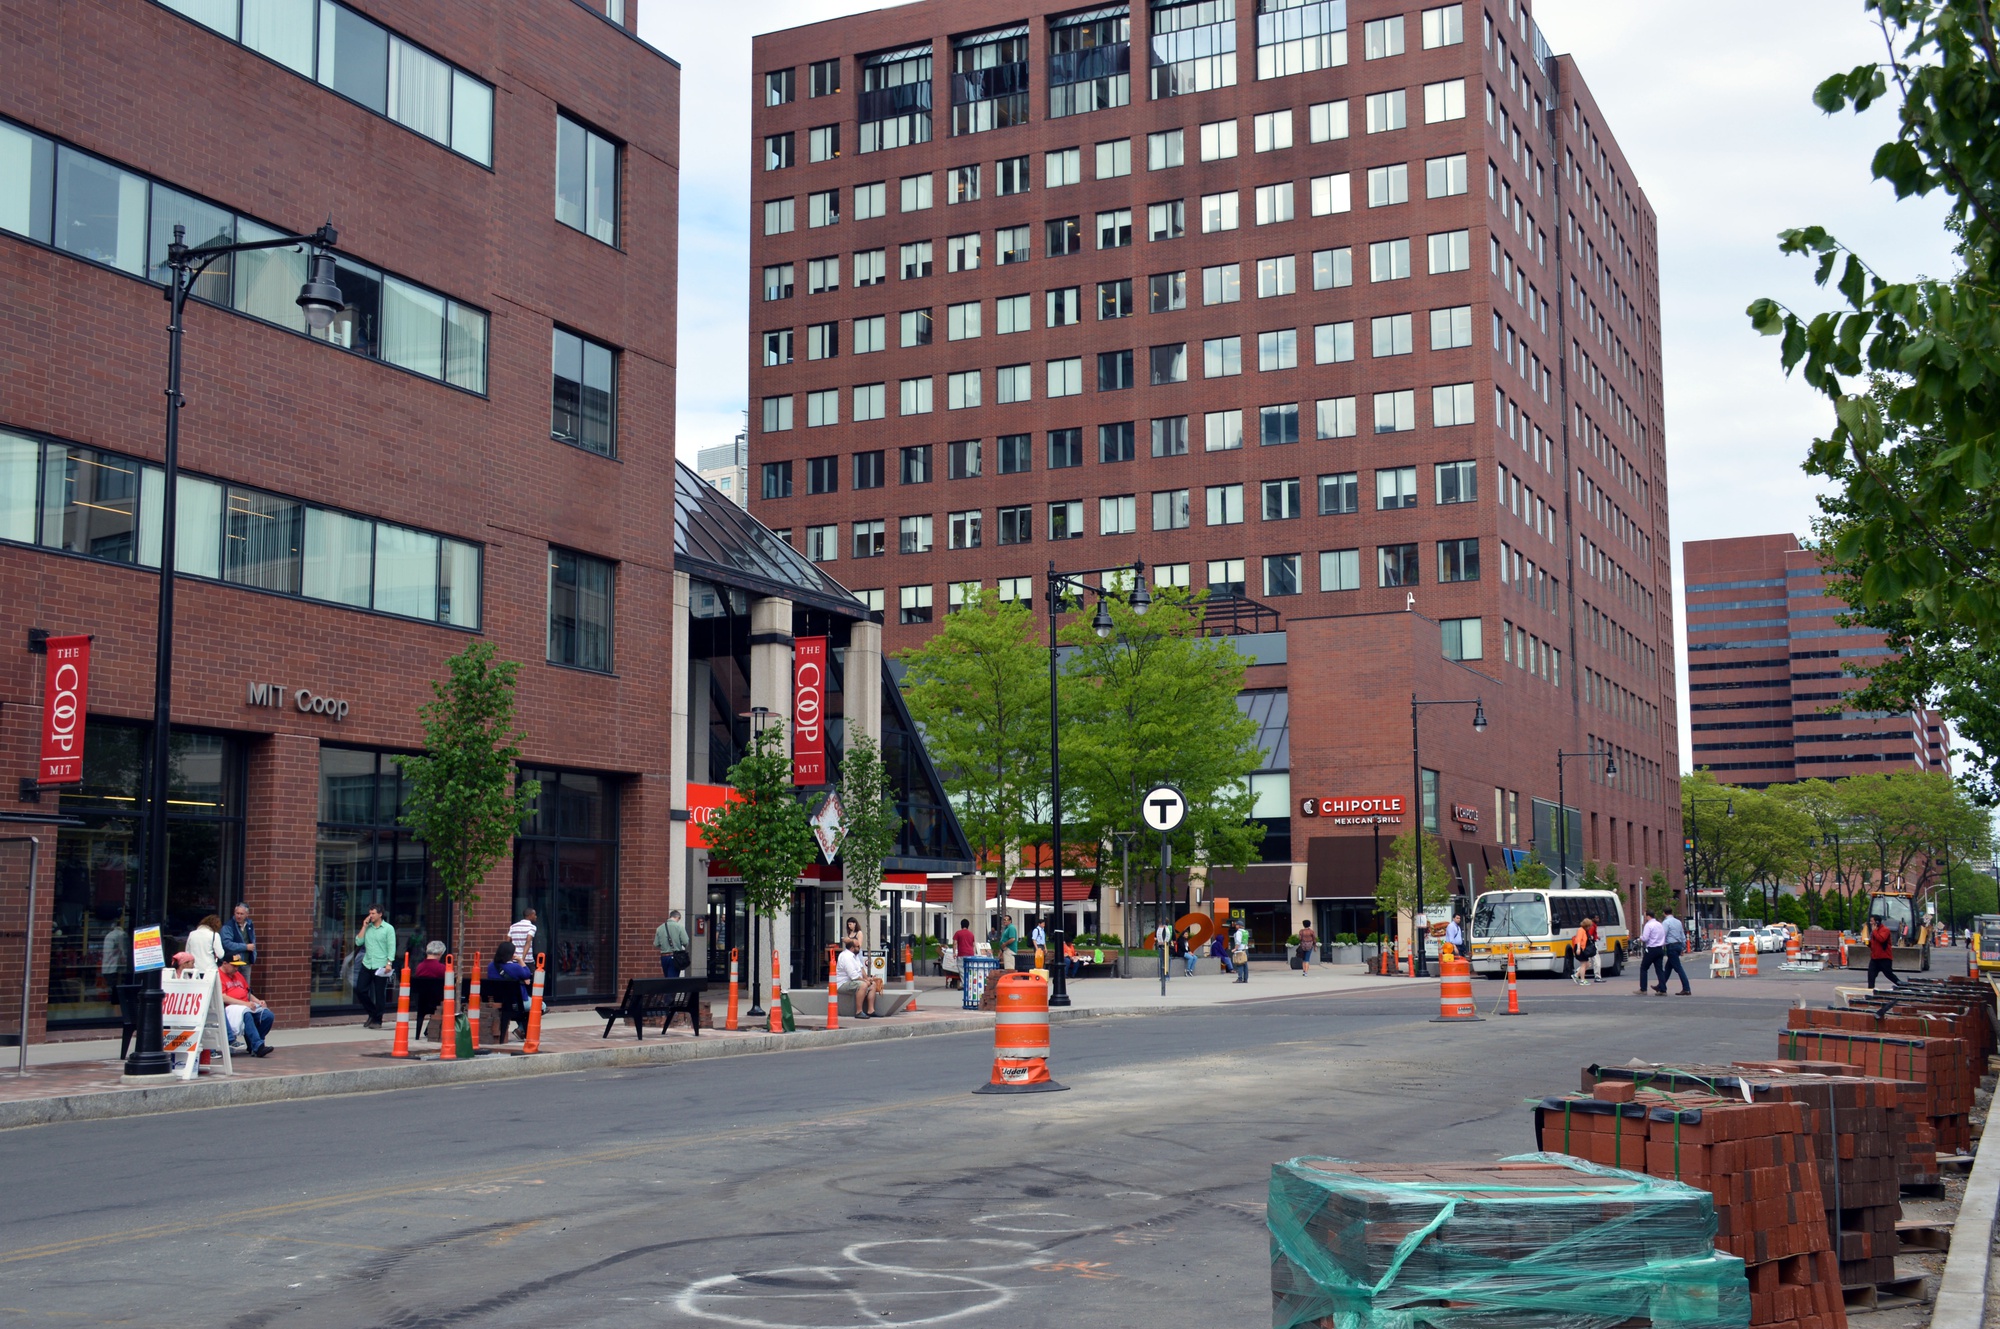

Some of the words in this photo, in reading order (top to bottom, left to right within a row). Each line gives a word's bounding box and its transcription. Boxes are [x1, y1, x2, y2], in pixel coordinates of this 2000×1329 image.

[57, 648, 80, 658] THE
[800, 646, 821, 655] THE
[52, 663, 79, 752] COOP
[246, 681, 288, 708] MIT
[294, 689, 350, 721] Coop
[797, 662, 821, 742] COOP
[50, 764, 72, 776] MIT
[798, 764, 820, 774] MIT
[1150, 799, 1177, 824] T
[1322, 799, 1401, 813] CHIPOTLE
[1334, 817, 1373, 825] MEXICAN
[162, 992, 203, 1016] ROLLEYS
